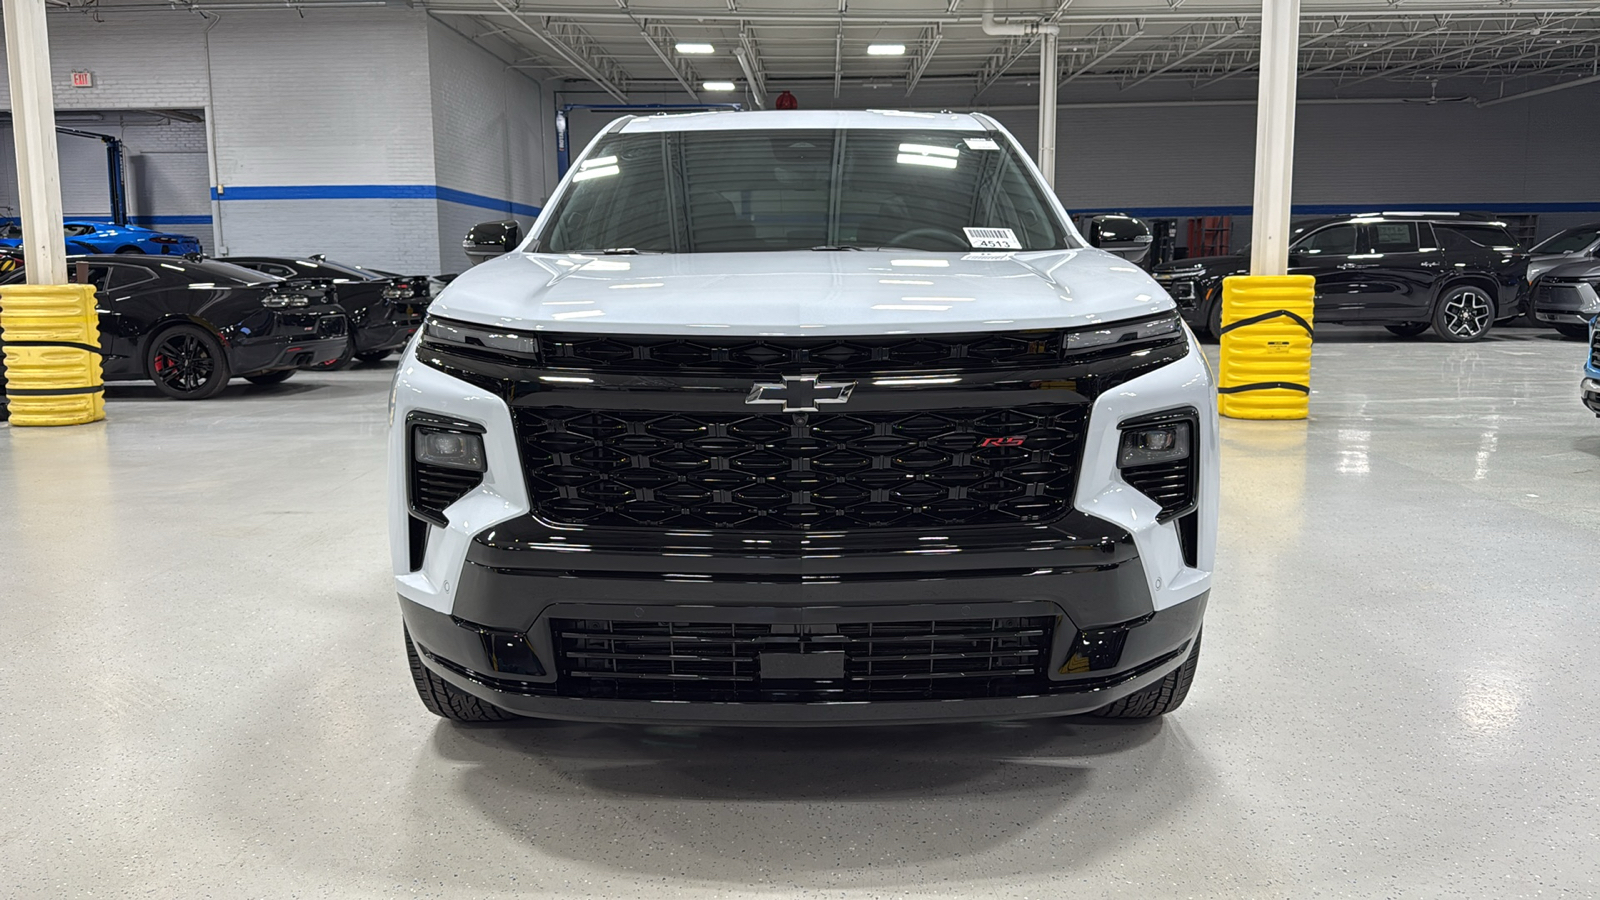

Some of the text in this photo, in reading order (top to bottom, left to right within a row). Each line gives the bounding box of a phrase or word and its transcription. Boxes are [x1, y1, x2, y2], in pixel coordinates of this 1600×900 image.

[74, 73, 88, 85] EXIT
[980, 240, 1011, 248] 4513
[980, 436, 1026, 447] RS
